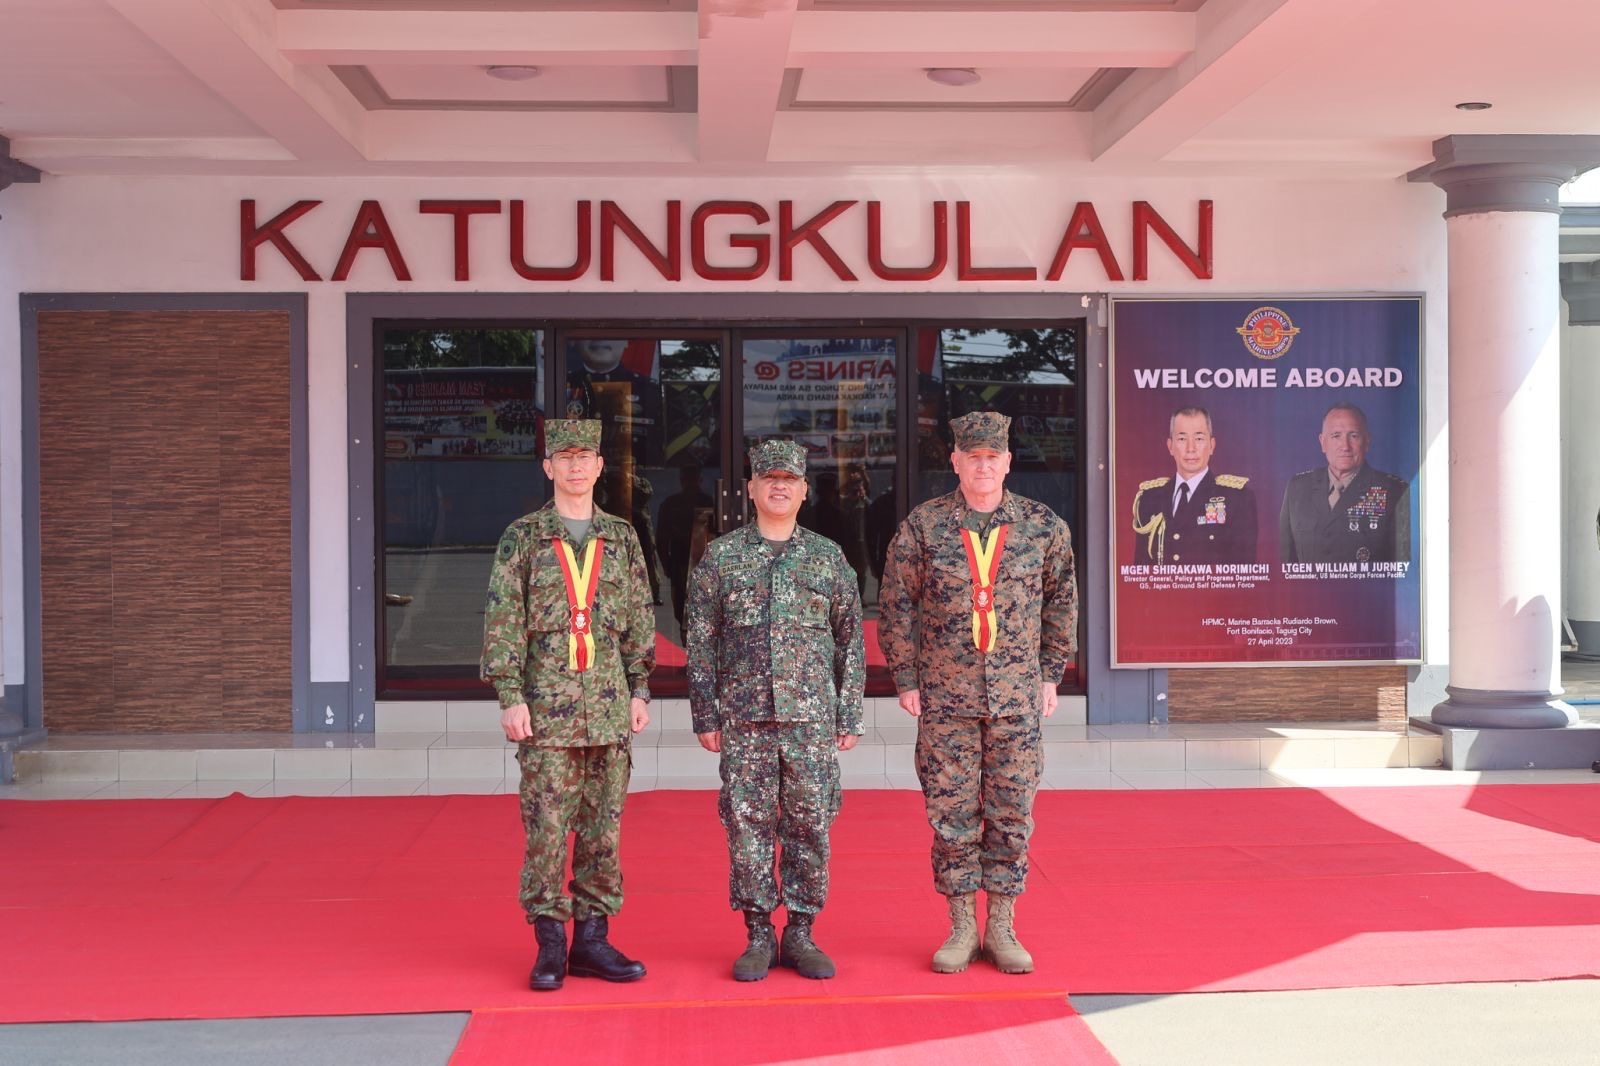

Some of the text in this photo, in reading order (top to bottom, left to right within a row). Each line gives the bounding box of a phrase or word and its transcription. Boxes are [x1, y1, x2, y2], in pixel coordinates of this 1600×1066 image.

[240, 200, 1213, 281] KATUNGKULAN
[1248, 311, 1289, 330] PHILIPPINE
[1247, 336, 1289, 355] MARINE CORPS
[1134, 368, 1403, 388] WELCOME ABOARD
[1120, 564, 1270, 575] MGEN SHIRAKAWA NORIMICHI
[1281, 562, 1410, 573] LTGEN WILLIAM M JURNEY
[1175, 575, 1193, 583] Policy
[1206, 575, 1233, 583] Programs
[1349, 572, 1366, 580] Corps
[1282, 617, 1313, 625] Rudiardo
[1314, 617, 1338, 625] Brown,
[1226, 627, 1312, 636] Fort Bonifacio, Taguig City
[1258, 638, 1274, 646] April
